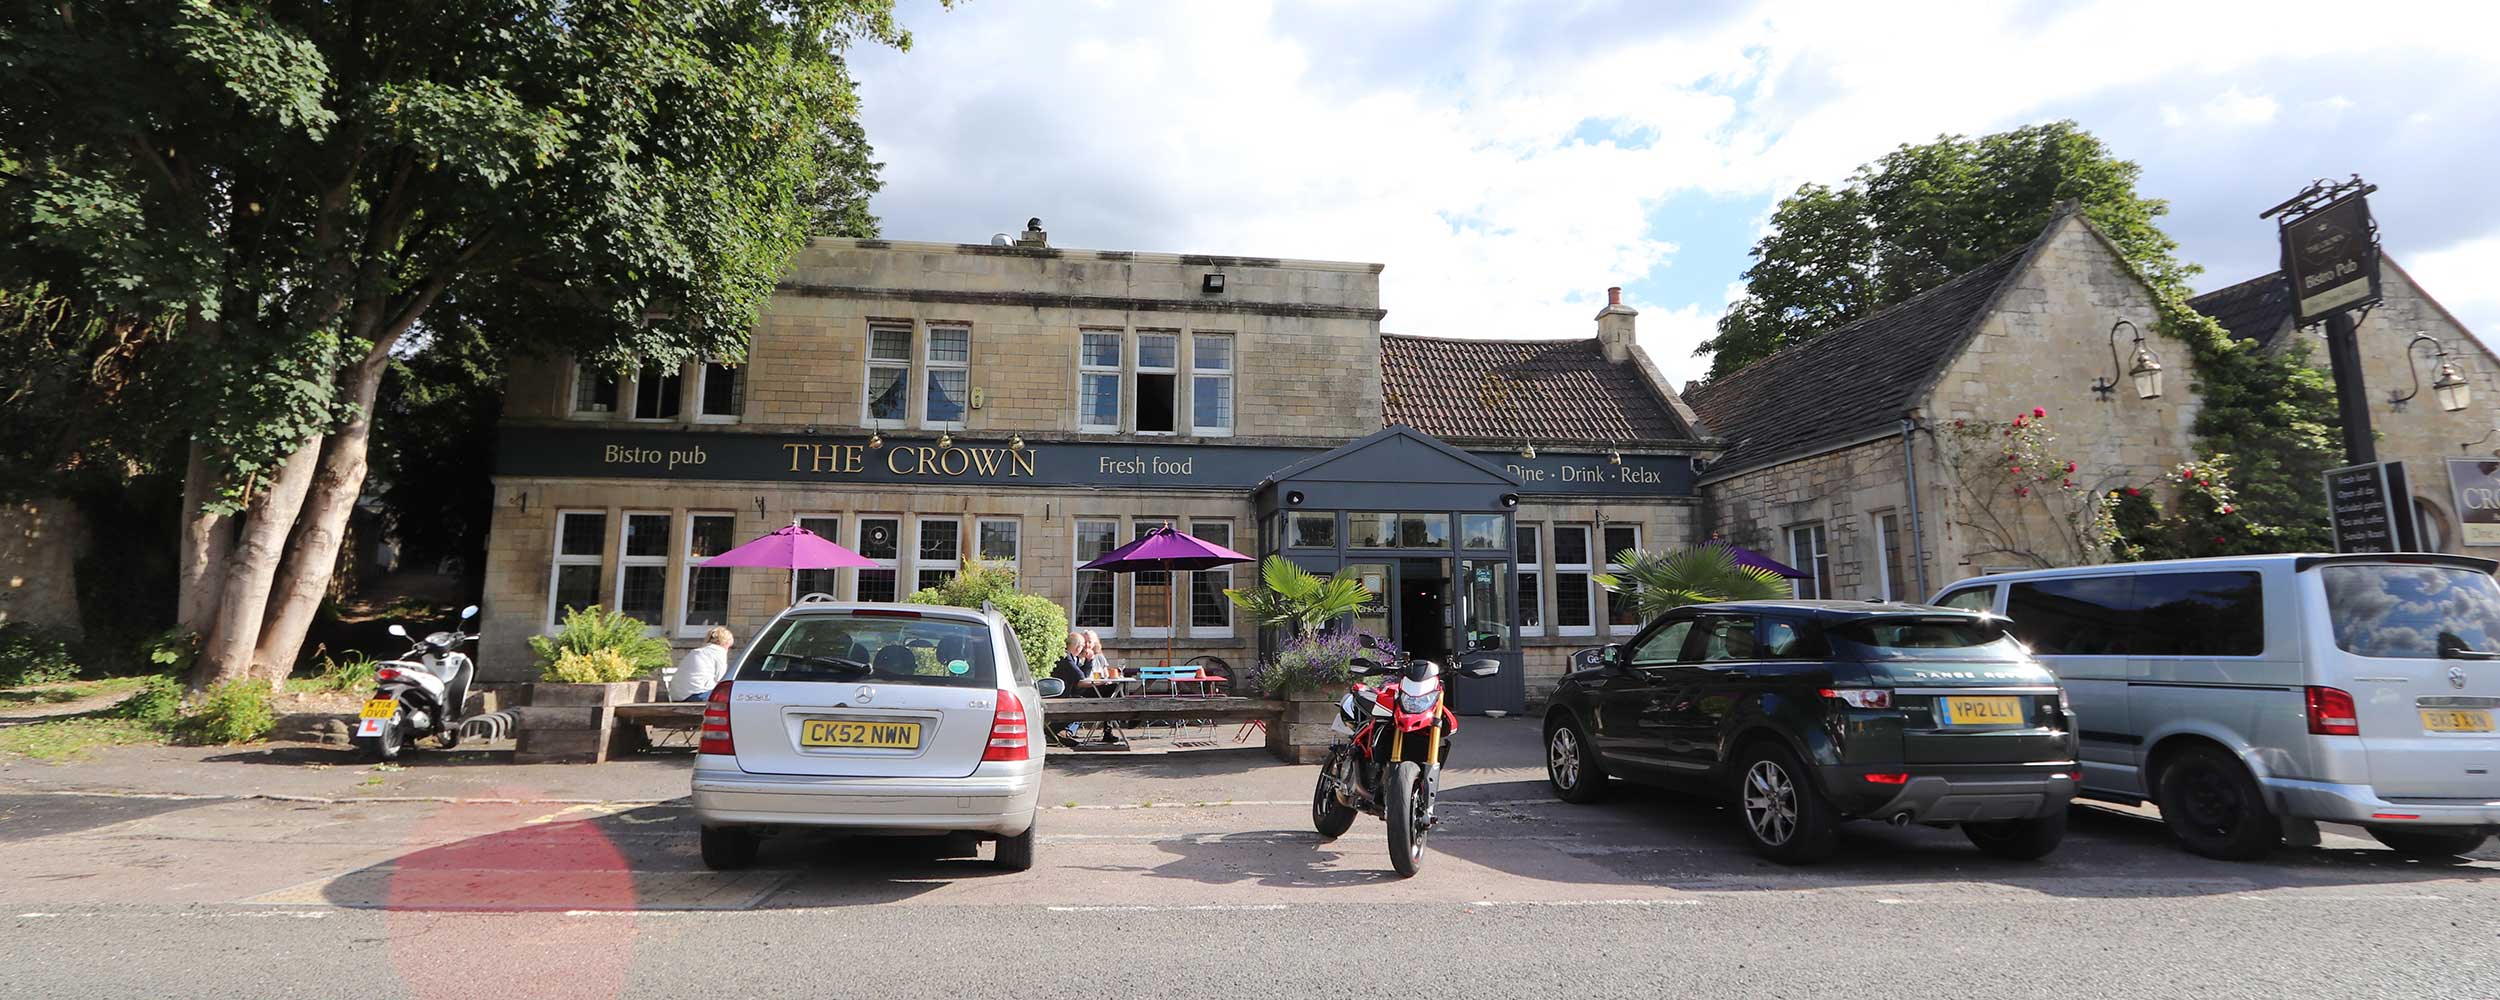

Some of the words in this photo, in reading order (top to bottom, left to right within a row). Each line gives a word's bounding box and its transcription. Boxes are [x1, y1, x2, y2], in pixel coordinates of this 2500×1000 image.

[2305, 270, 2335, 288] Bistro
[2336, 258, 2358, 277] Pub
[604, 444, 662, 465] Bistro
[669, 445, 708, 471] pub
[783, 443, 865, 474] THE
[887, 446, 1036, 477] CROWN
[1100, 456, 1145, 475] Fresh
[1152, 456, 1193, 476] food
[1506, 464, 1545, 481] Dine
[1561, 465, 1606, 482] Drink
[1620, 466, 1662, 484] Relax
[2463, 487, 2500, 511] CR
[1914, 671, 1975, 680] RANGE
[1954, 702, 1987, 718] YP12
[366, 720, 378, 731] L
[811, 724, 866, 743] CK52
[871, 725, 912, 745] NWN
